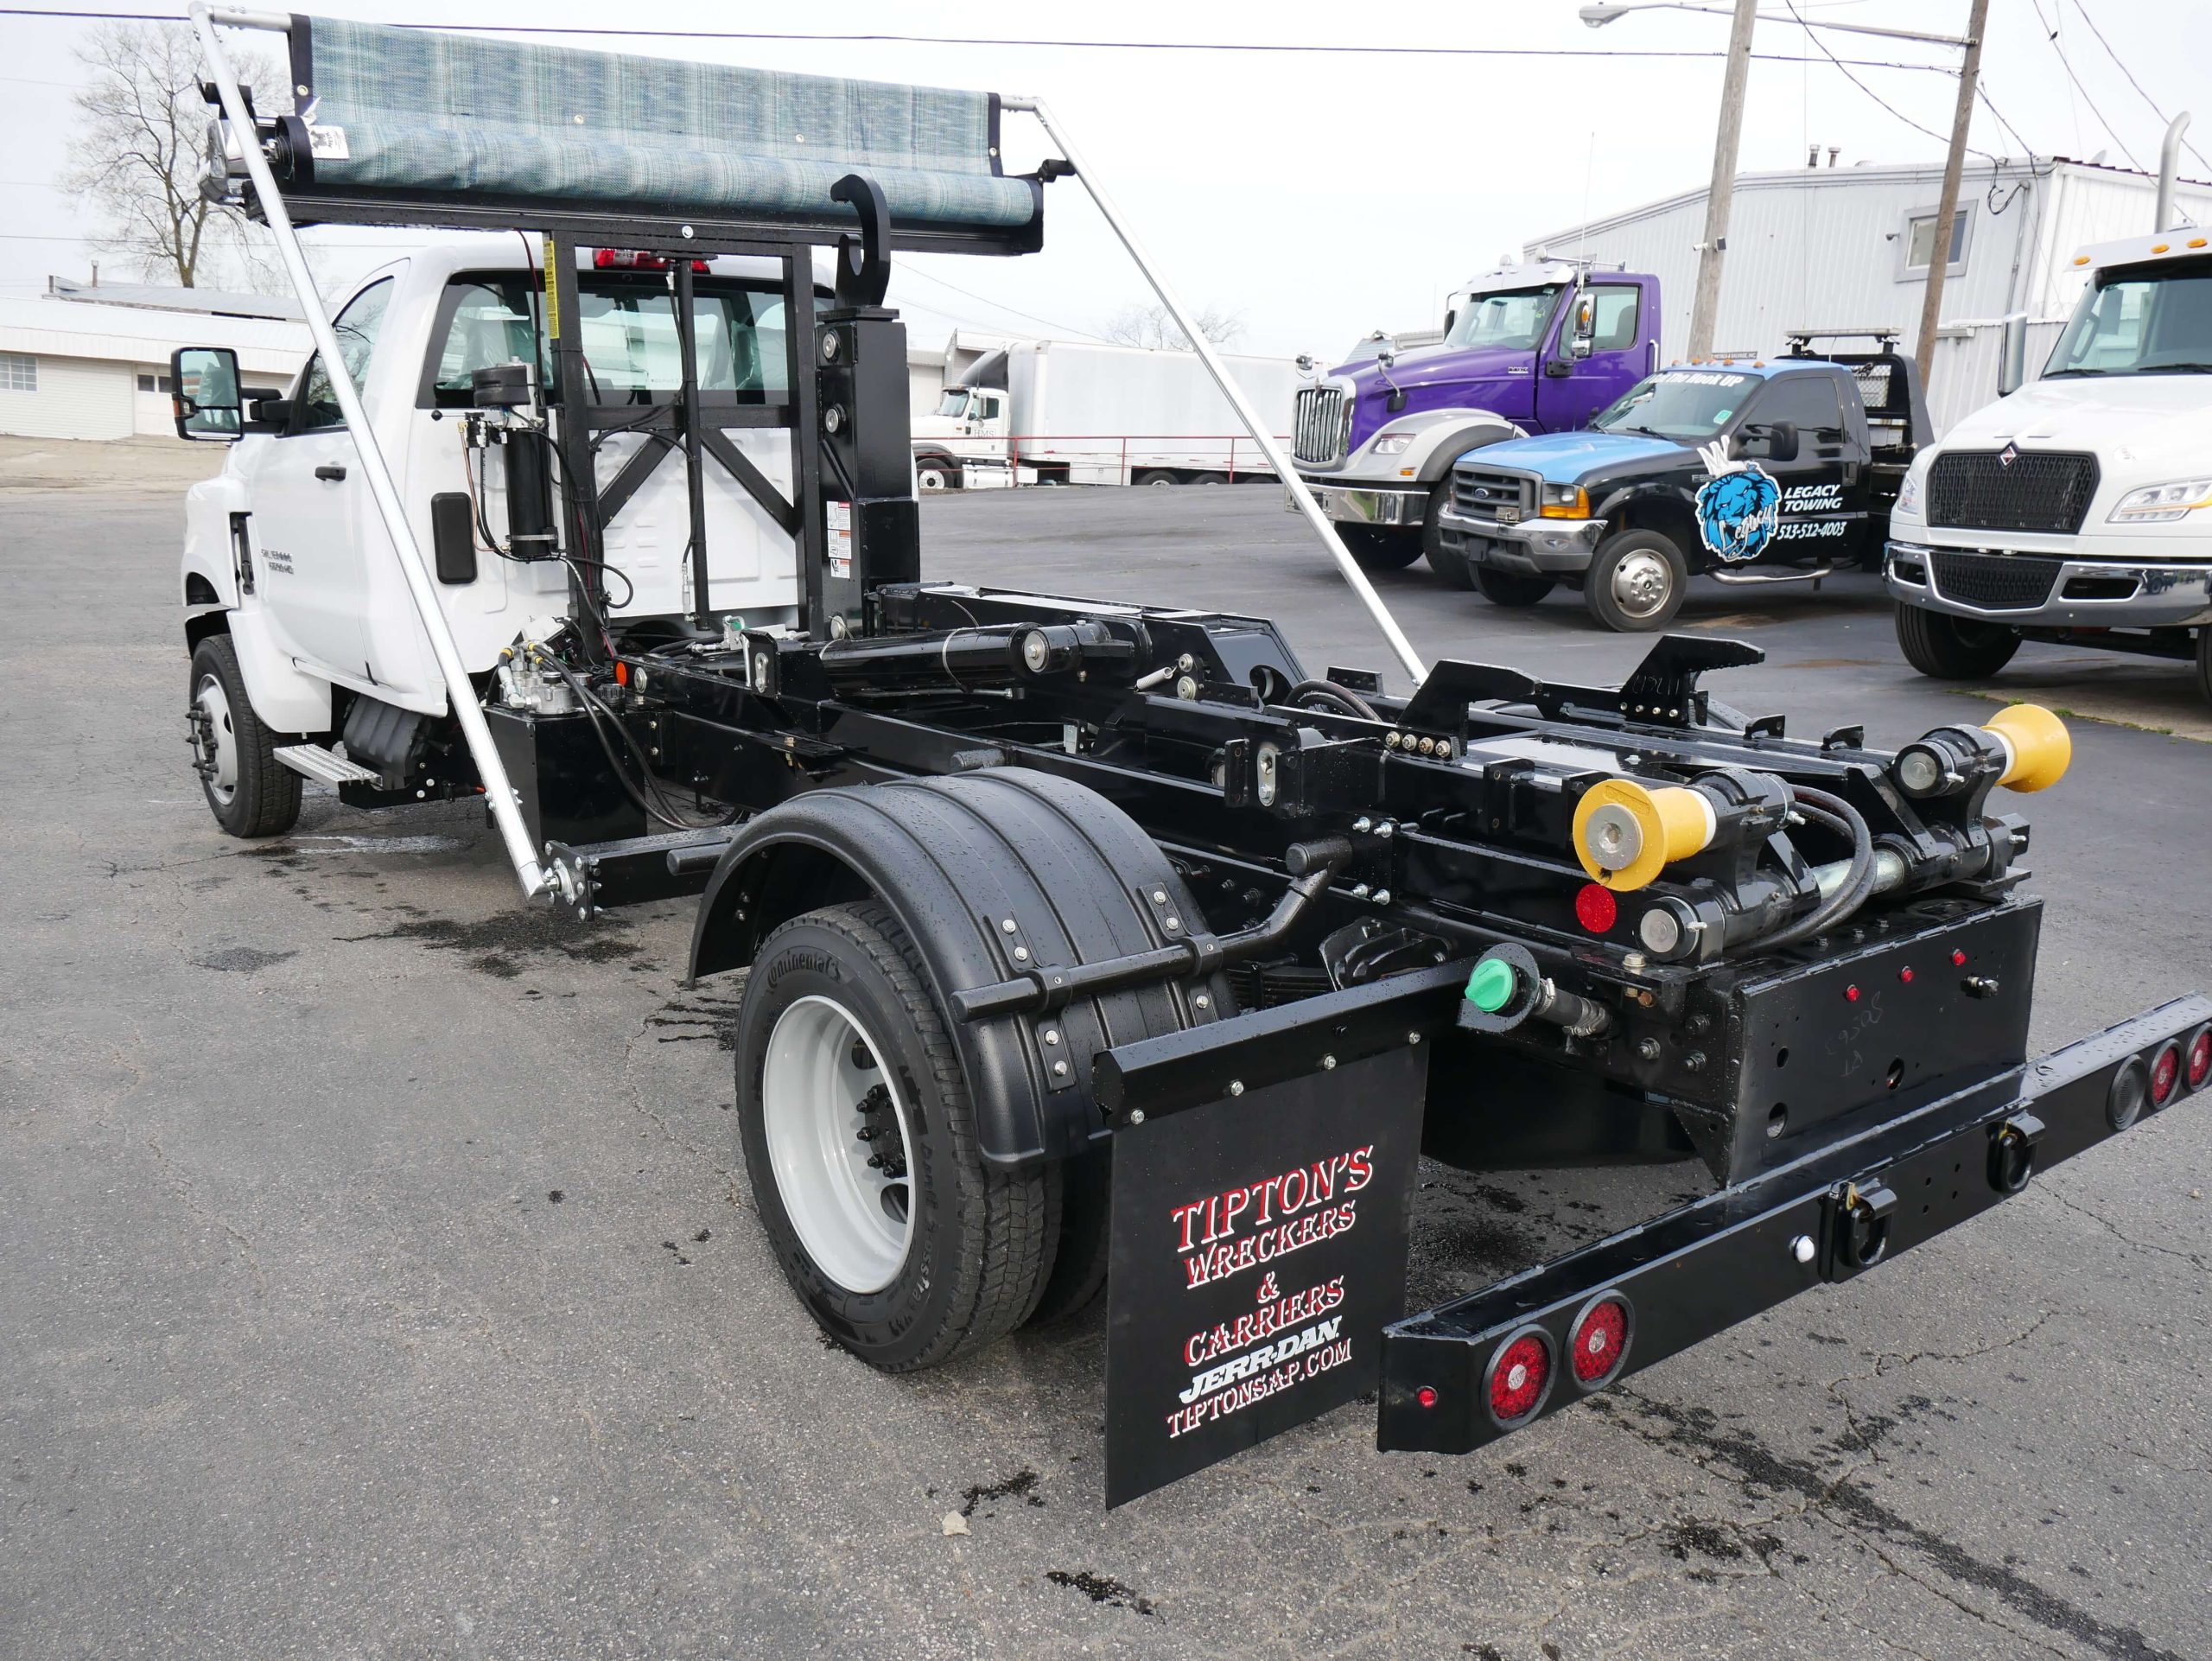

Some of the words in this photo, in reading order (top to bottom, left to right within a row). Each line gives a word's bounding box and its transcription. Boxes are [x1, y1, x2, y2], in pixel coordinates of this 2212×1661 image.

[1666, 372, 1690, 383] The
[1685, 373, 1722, 385] Hook
[1719, 375, 1745, 387] UP
[1783, 484, 1841, 499] LEGACY
[1783, 498, 1843, 512] TOWING
[1718, 503, 1774, 559] Legacy
[1777, 521, 1847, 540] 513-512-4003
[1170, 1144, 1374, 1253] TIPTON'S
[1183, 1200, 1357, 1289] WRECKERS
[1255, 1270, 1281, 1304] &
[1184, 1275, 1344, 1367] CARRIERS
[1166, 1337, 1353, 1438] TIPTONSAP.COM
